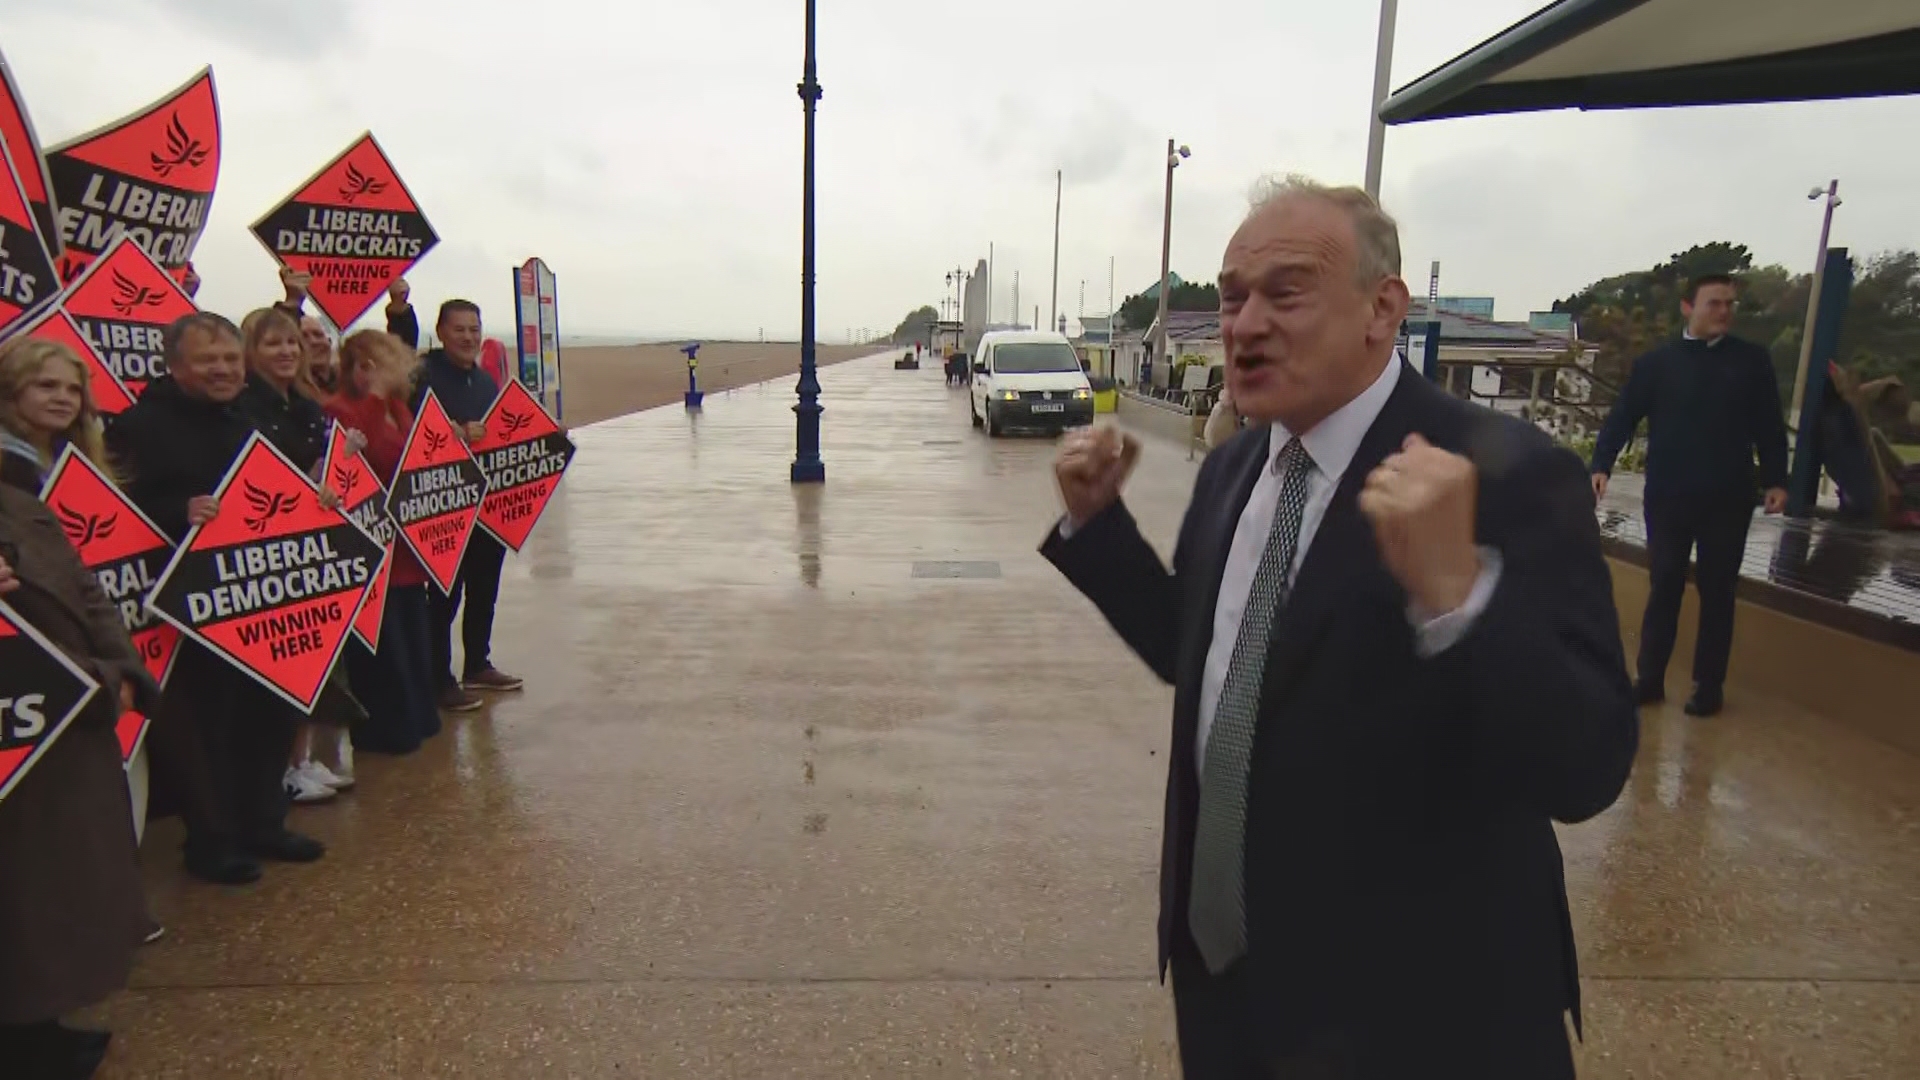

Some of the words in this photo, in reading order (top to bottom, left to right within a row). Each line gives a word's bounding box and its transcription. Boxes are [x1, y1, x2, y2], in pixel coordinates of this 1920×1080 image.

[59, 206, 197, 265] EMOCR
[307, 207, 402, 235] LIBERAL
[277, 229, 422, 257] DEMOCRATS
[308, 262, 391, 279] WINNING
[327, 280, 369, 294] HERE
[82, 321, 164, 351] LIBER
[478, 439, 550, 473] LIBERAL
[486, 452, 565, 491] MOCRATS
[411, 465, 465, 496] LIBERAL
[400, 483, 480, 523] DEMOCRATS
[484, 483, 547, 515] WINNING
[501, 503, 533, 525] HERE
[418, 515, 465, 543] WINNING
[215, 533, 338, 582] LIBERAL
[431, 535, 456, 556] HERE
[187, 556, 369, 623] DEMOCRATS
[236, 601, 342, 647] WINNING
[269, 629, 324, 662] HERE
